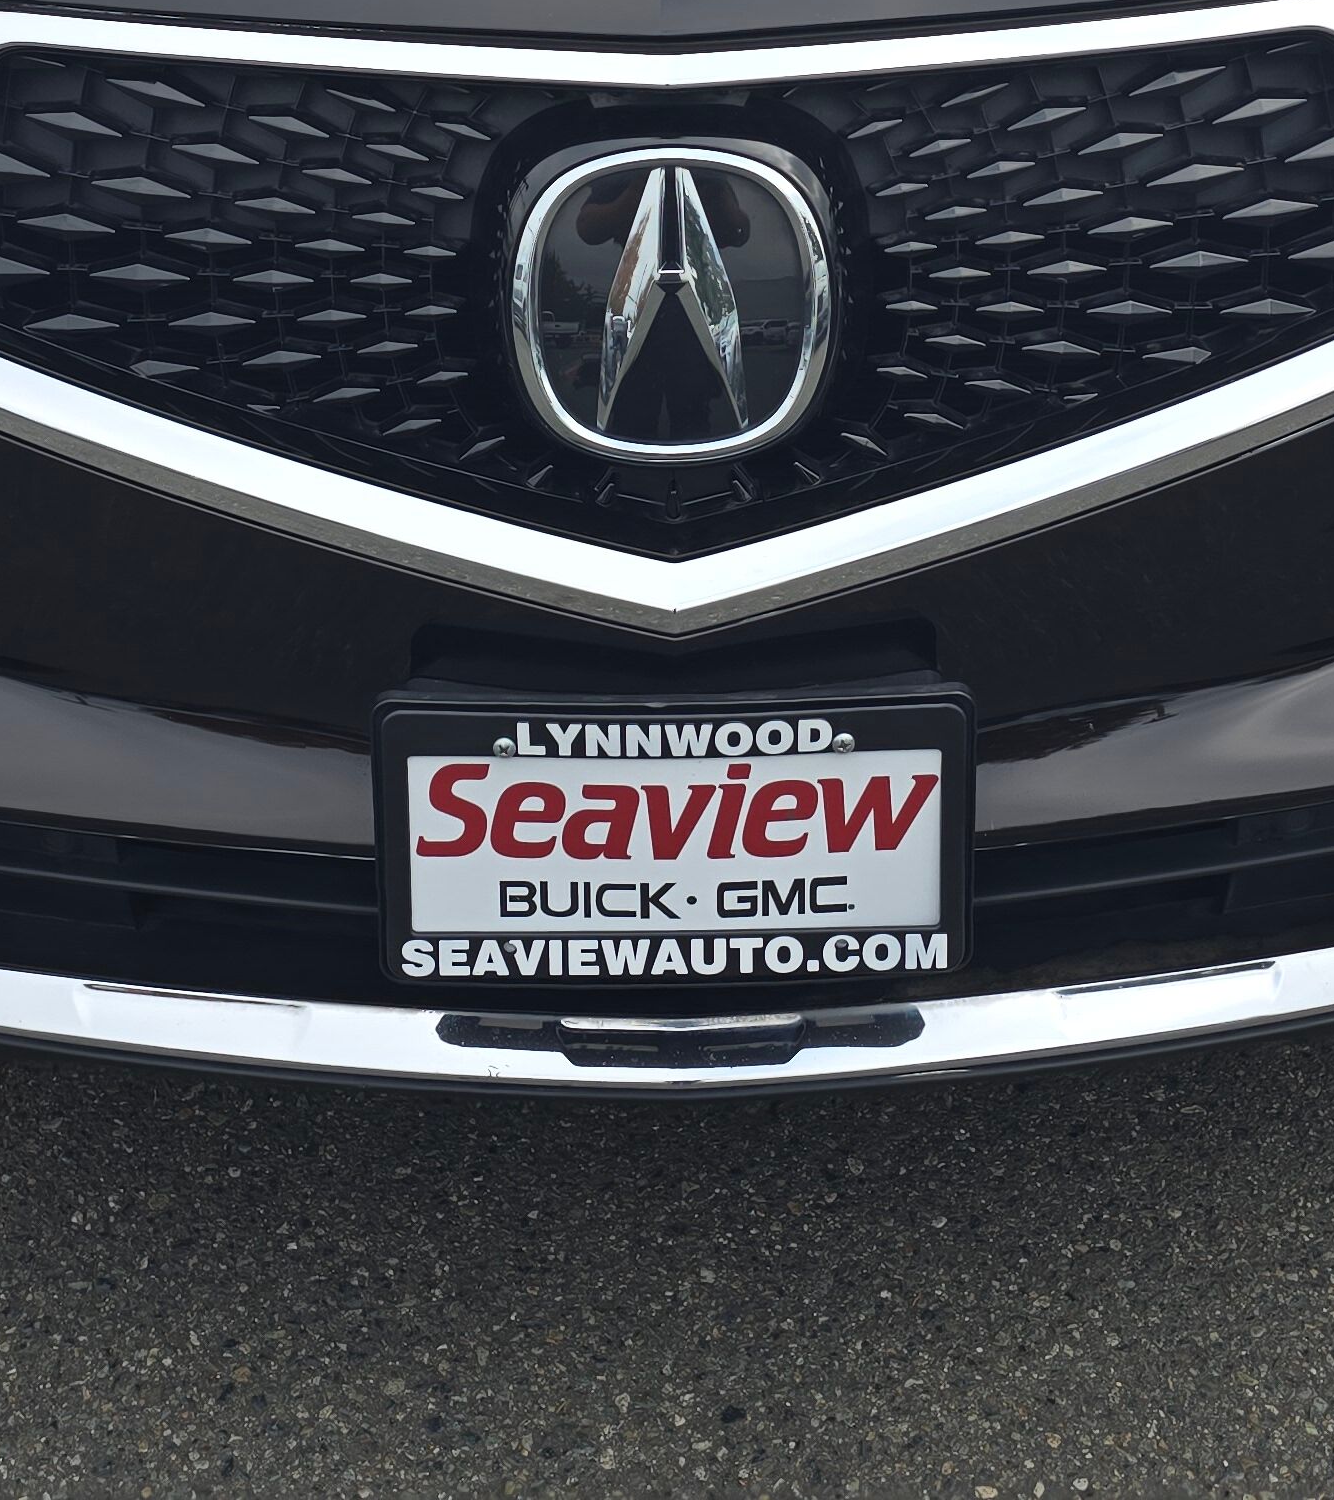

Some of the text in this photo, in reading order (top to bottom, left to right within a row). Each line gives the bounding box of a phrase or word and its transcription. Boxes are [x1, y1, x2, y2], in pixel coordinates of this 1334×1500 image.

[515, 718, 834, 758] LYNNWOOD
[415, 762, 940, 861] Seaview
[498, 875, 851, 920] BUICK GMC
[400, 932, 949, 978] SEAVIEWAUTO.COM
